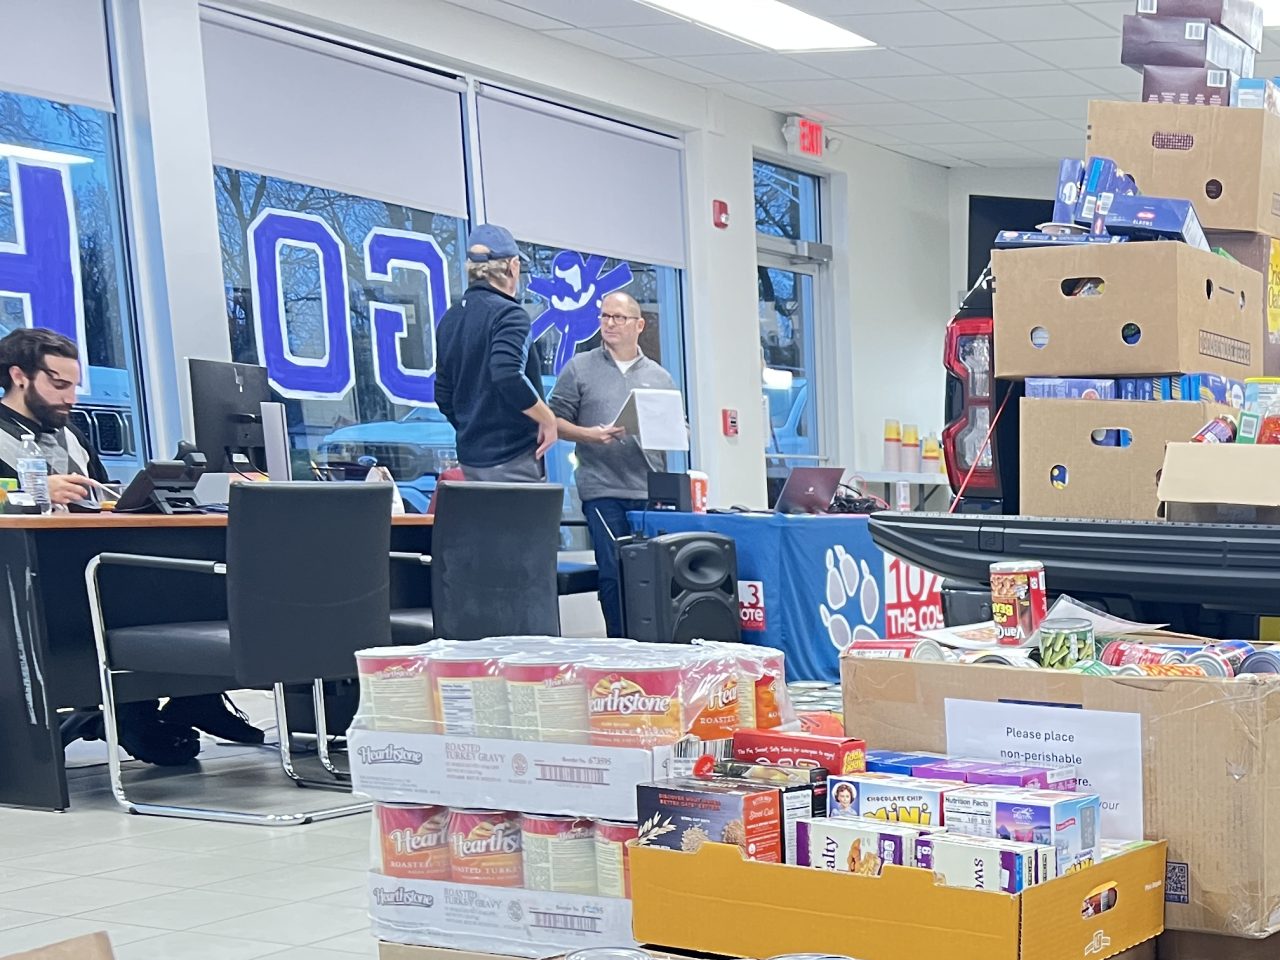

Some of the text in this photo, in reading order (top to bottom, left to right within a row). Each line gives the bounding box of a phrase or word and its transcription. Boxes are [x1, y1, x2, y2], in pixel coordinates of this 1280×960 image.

[590, 692, 671, 715] earthstone
[1006, 727, 1074, 743] Please place
[357, 744, 423, 765] Hearthstone
[445, 743, 481, 753] ROASTED
[446, 750, 506, 763] TURKEY GRAVY
[1000, 749, 1082, 765] non-perishable
[945, 797, 988, 807] Nutrition Facts
[373, 887, 434, 908] Hearthstone
